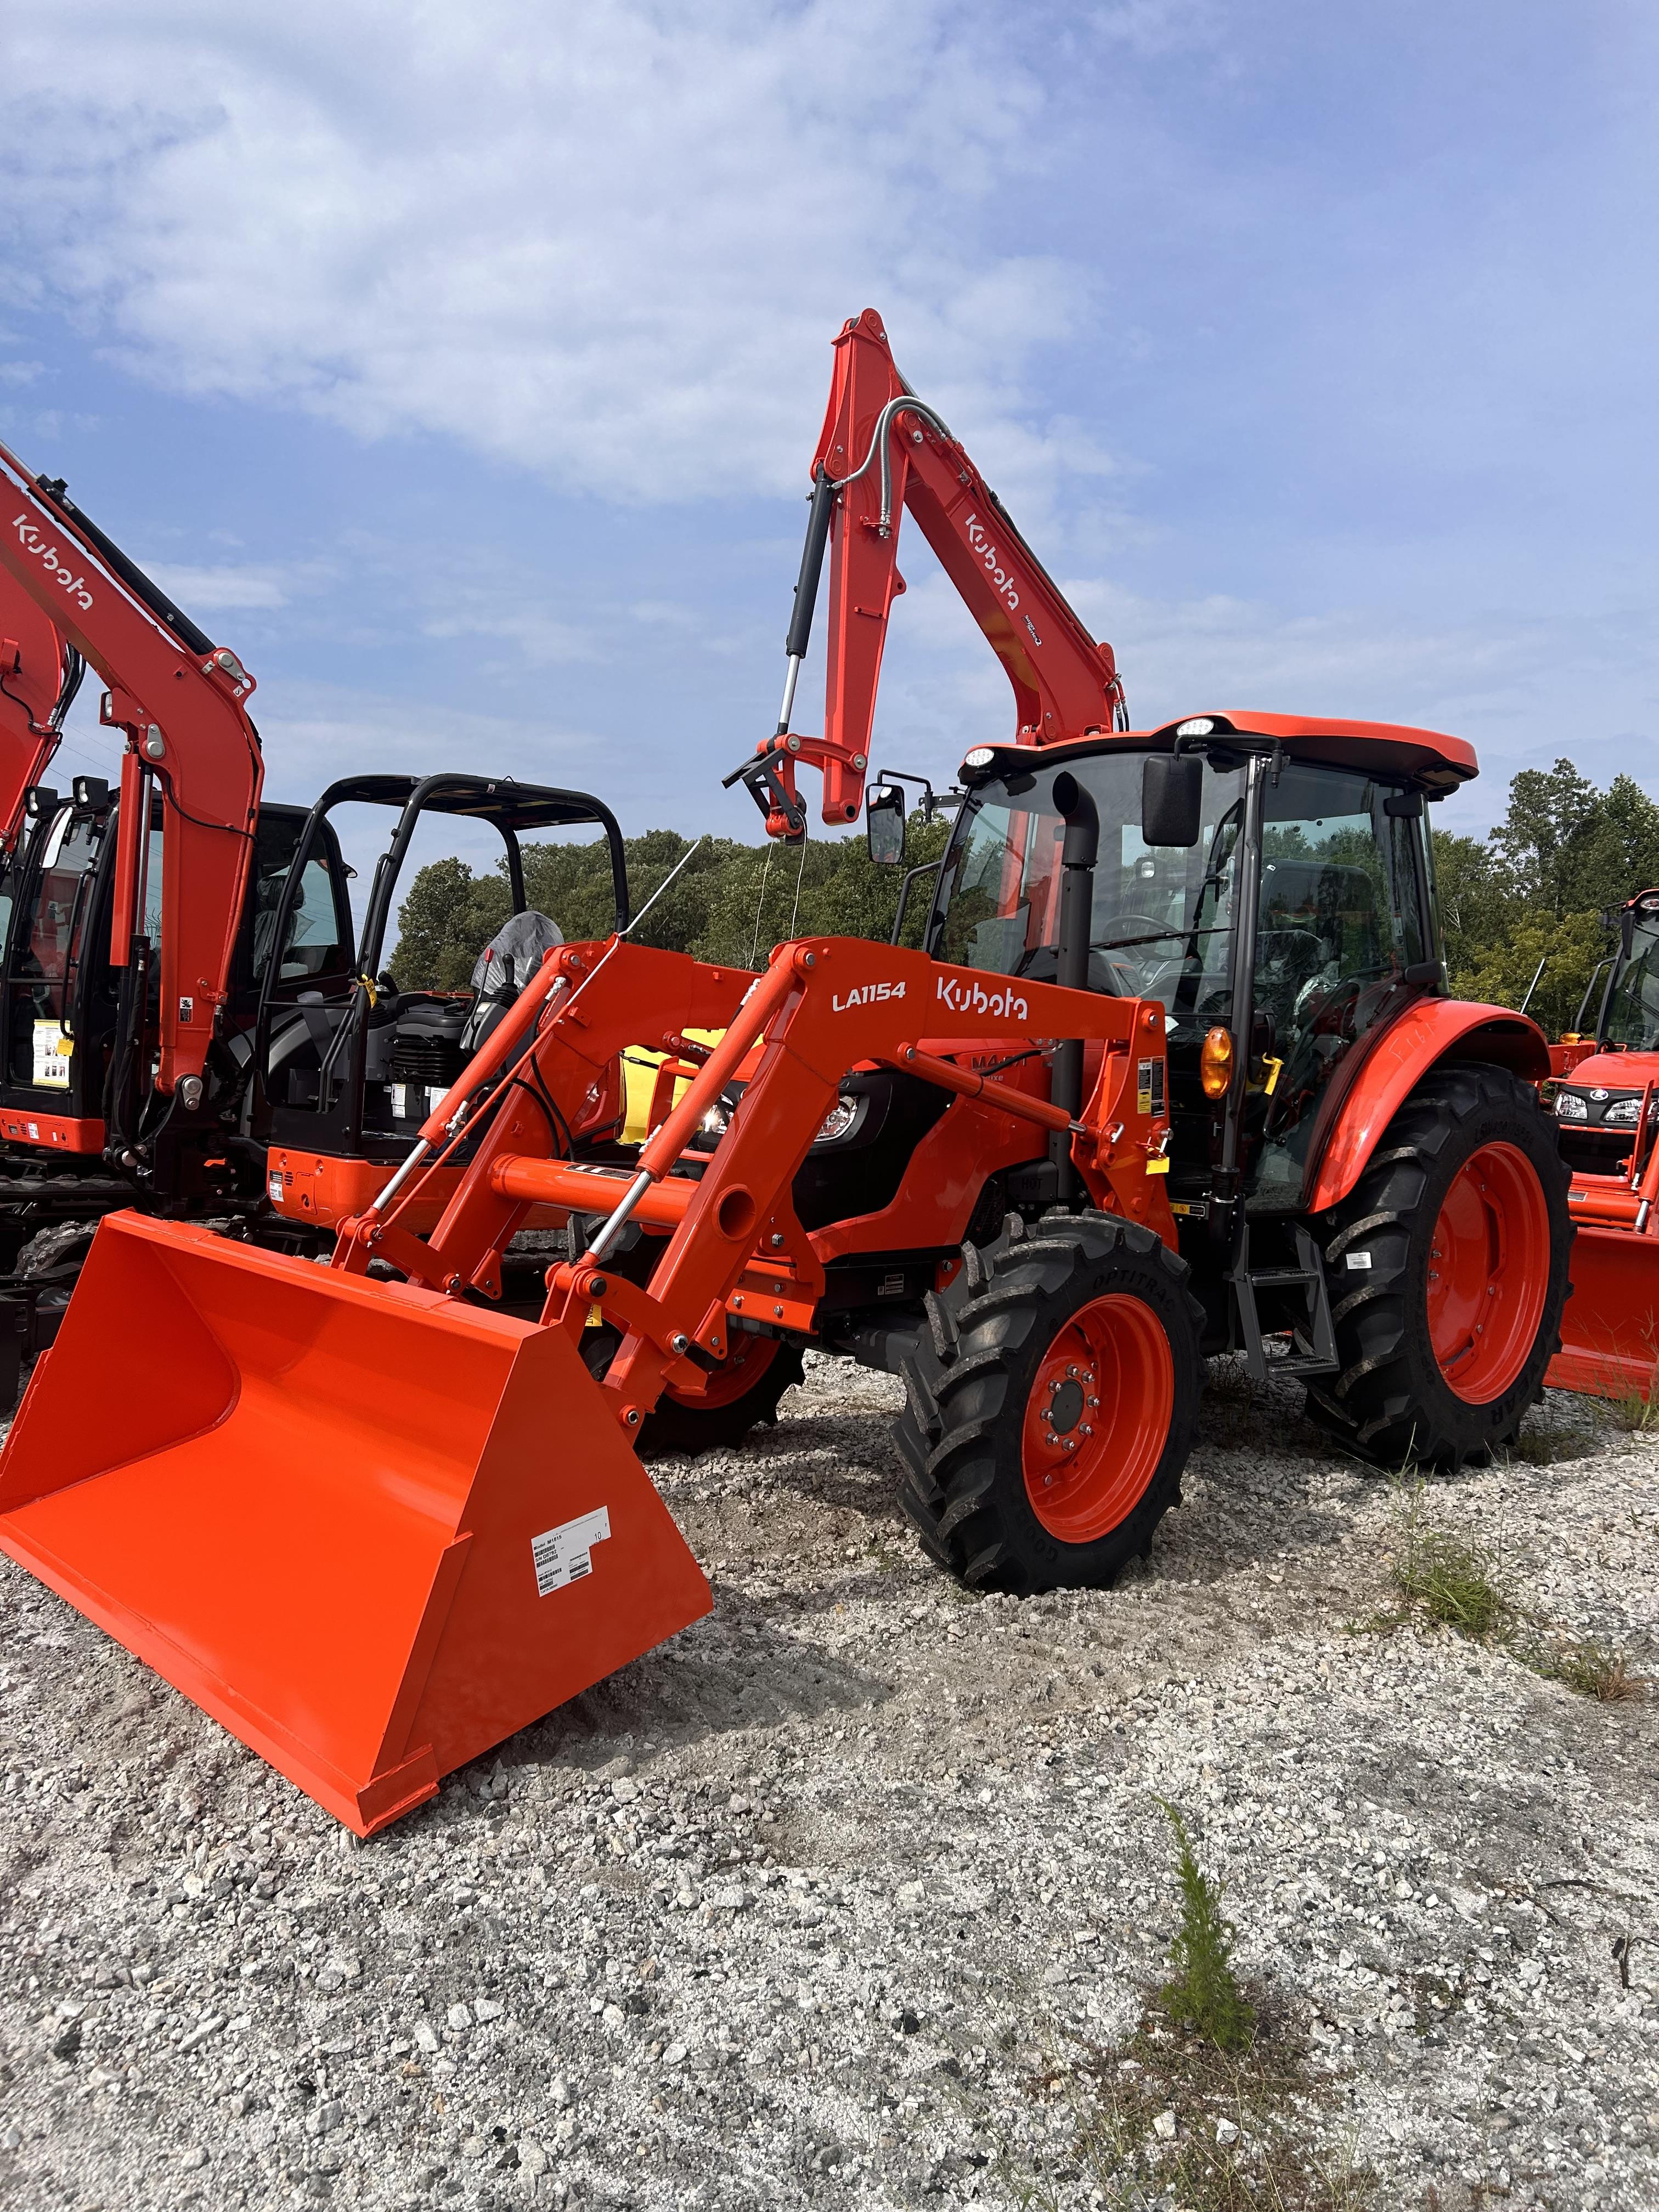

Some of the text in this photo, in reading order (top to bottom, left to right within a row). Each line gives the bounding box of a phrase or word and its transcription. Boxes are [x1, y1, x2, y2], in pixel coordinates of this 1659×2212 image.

[12, 514, 94, 611] Kubota
[966, 513, 1019, 611] Kubota
[832, 981, 906, 1012] LA1154
[936, 977, 1028, 1020] Kubota
[1021, 1177, 1043, 1190] HOT
[1093, 1269, 1176, 1313] OPTITRAC
[594, 1531, 602, 1541] 10
